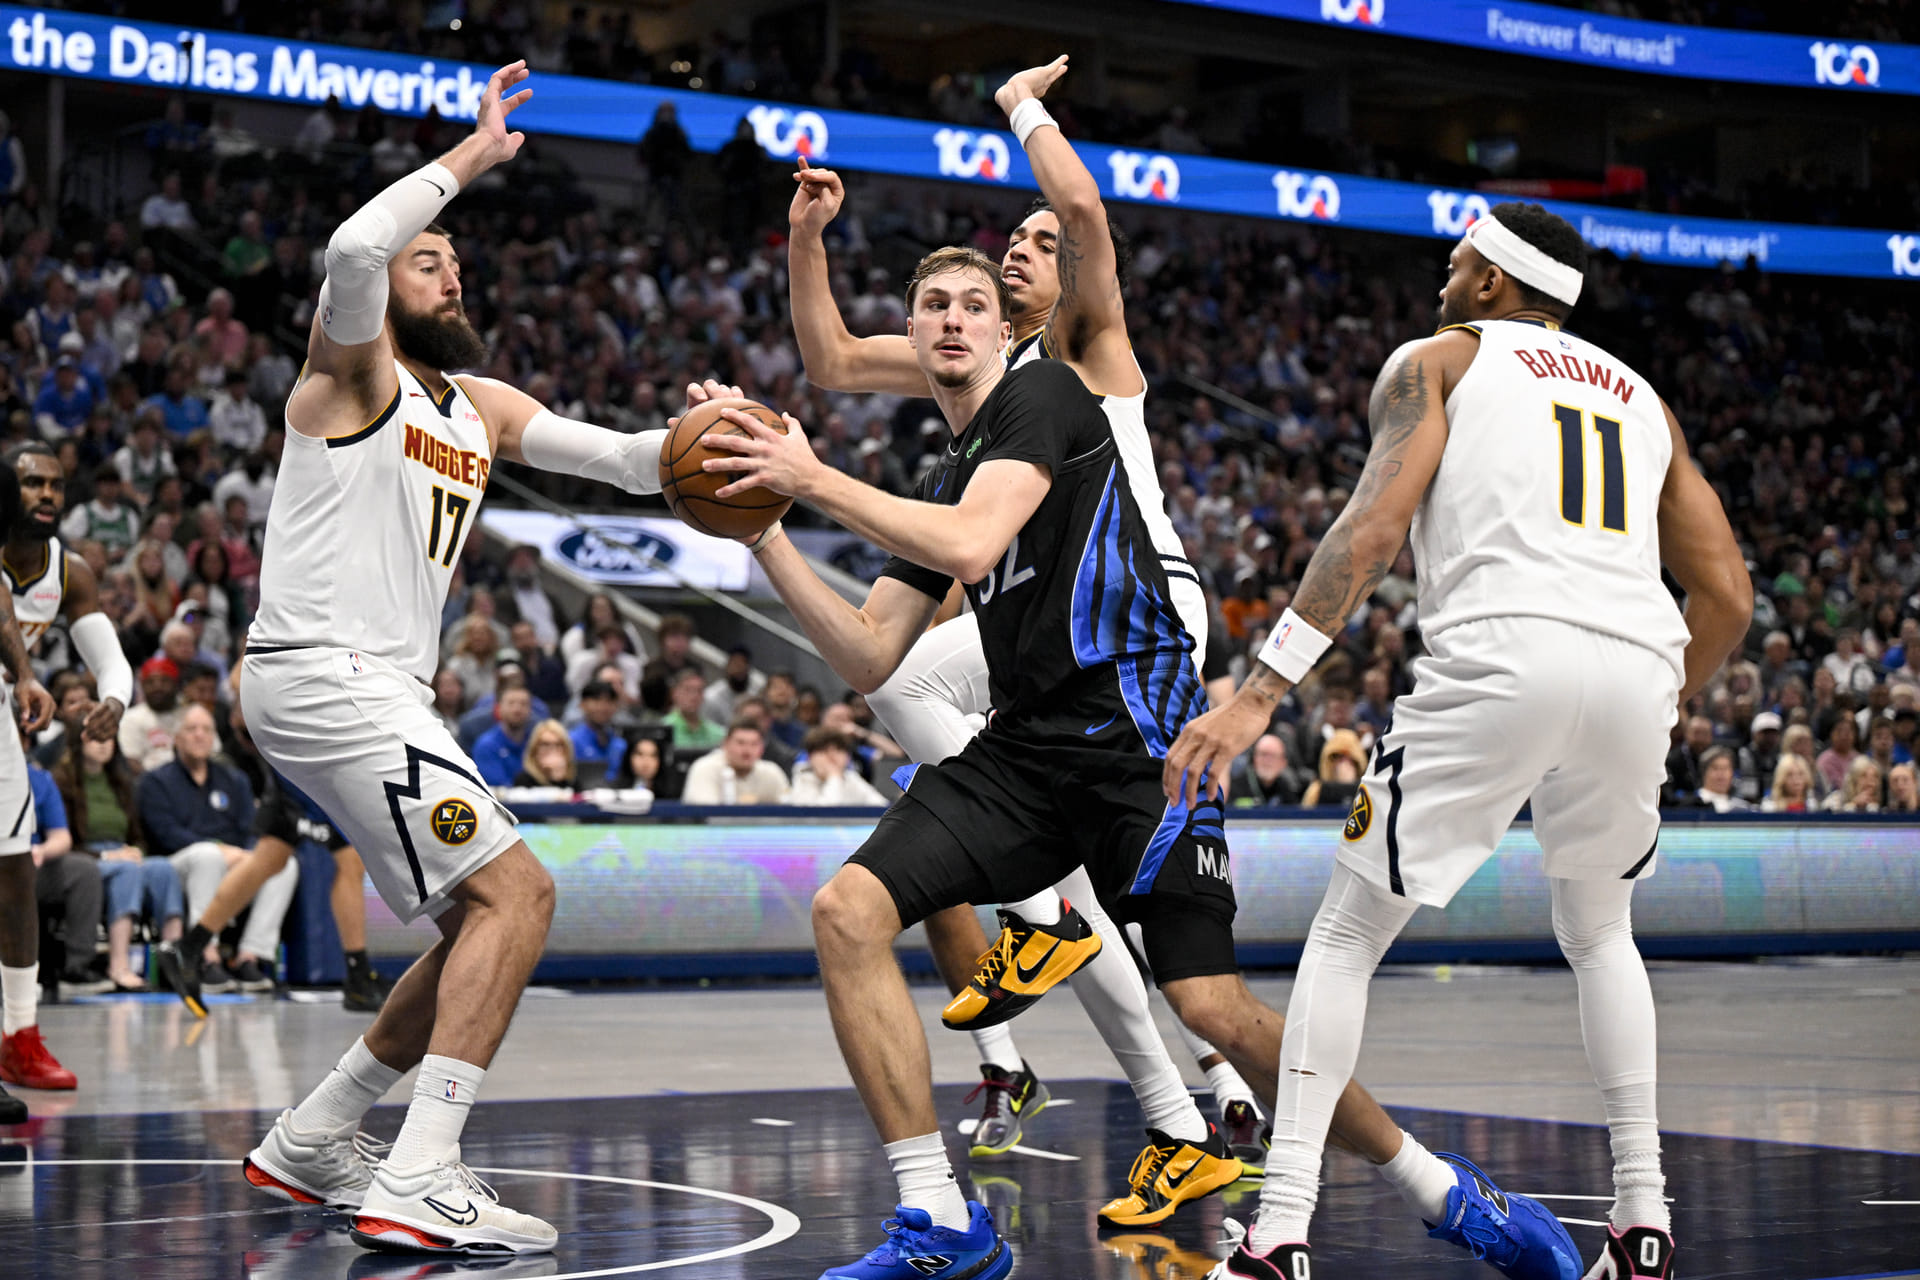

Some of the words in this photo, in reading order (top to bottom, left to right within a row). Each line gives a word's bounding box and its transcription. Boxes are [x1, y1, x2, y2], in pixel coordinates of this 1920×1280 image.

[8, 12, 96, 73] the
[1486, 8, 1575, 51] Forever
[1809, 41, 1880, 87] 100
[748, 105, 829, 160] 100
[933, 128, 1010, 182] 100
[1107, 150, 1180, 202] 100
[1272, 170, 1341, 221] 100
[1427, 190, 1490, 236] 100
[1581, 215, 1662, 252] Forever
[1513, 348, 1635, 405] BROWN
[1551, 400, 1629, 536] 11
[428, 484, 472, 568] 17
